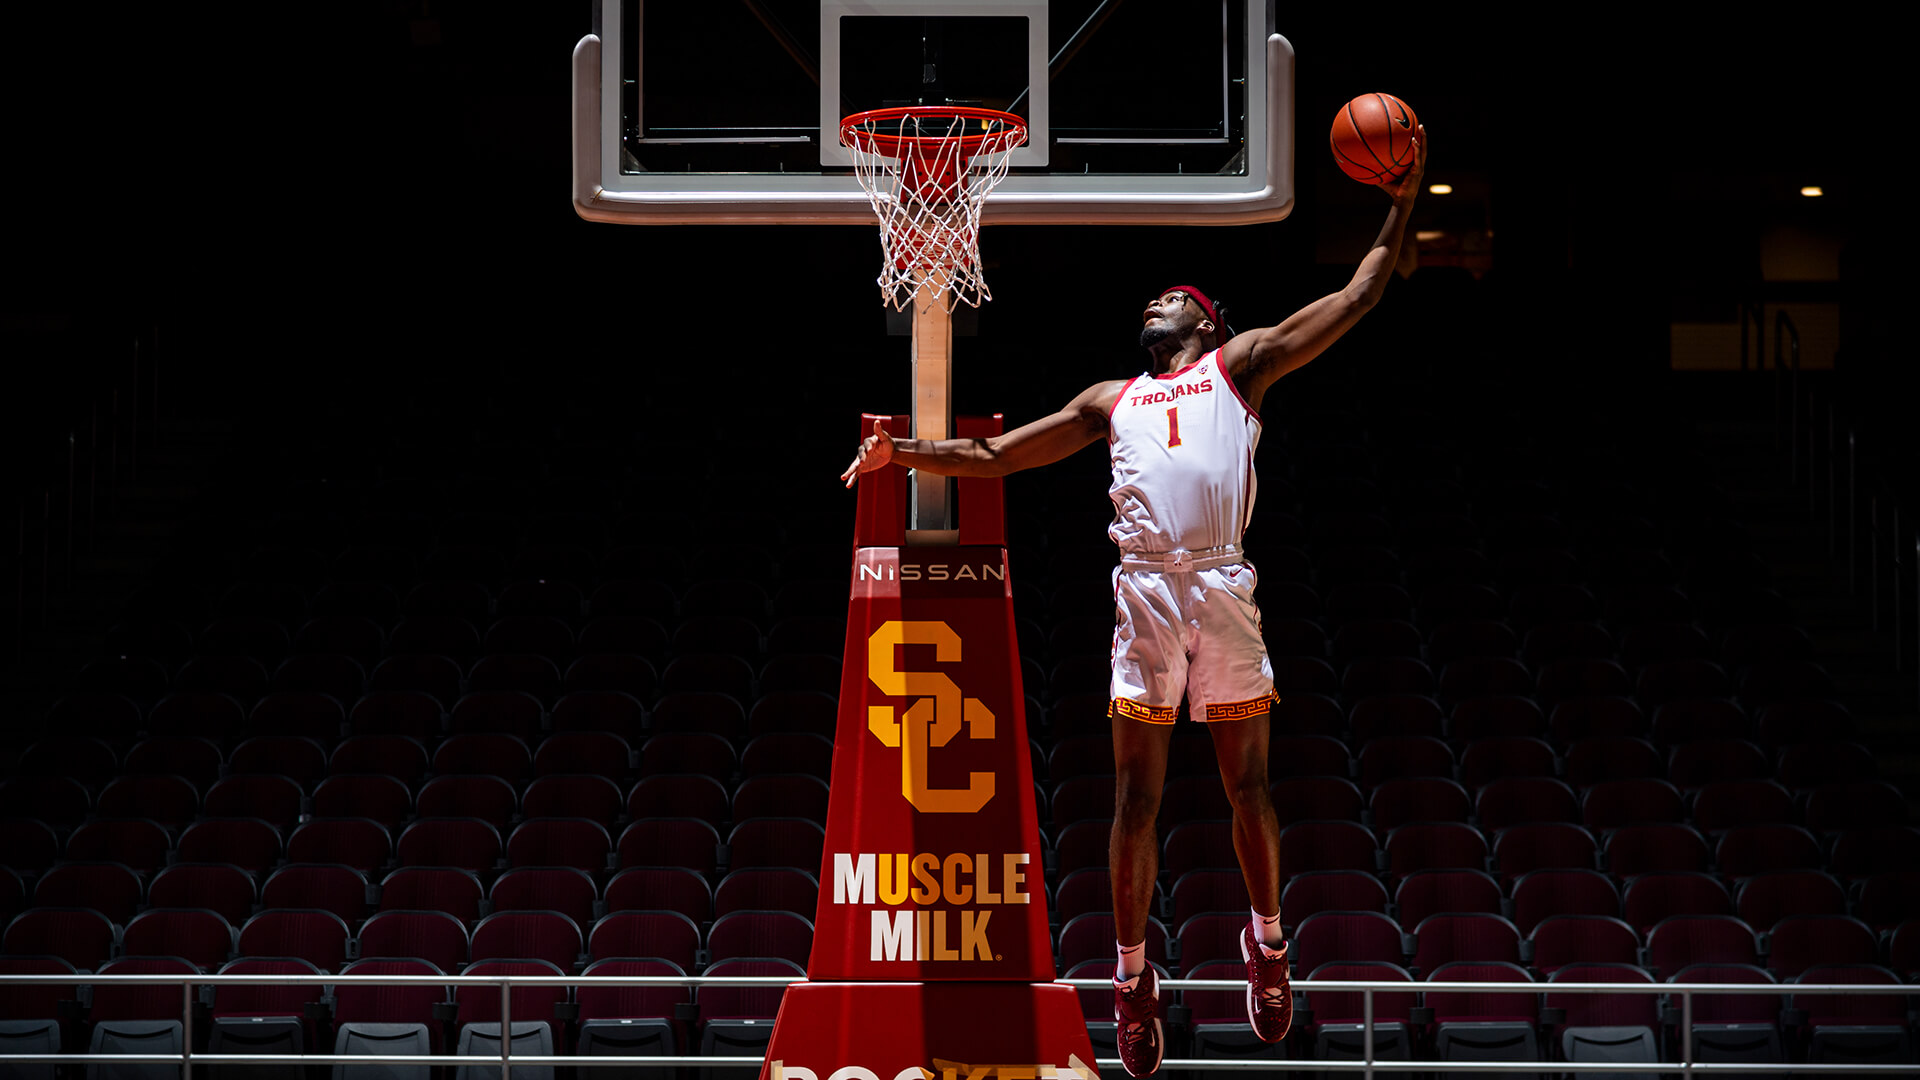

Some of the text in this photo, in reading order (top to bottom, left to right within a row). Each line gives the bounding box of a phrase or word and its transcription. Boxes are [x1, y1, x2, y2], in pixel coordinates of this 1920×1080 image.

[1130, 379, 1213, 407] TROJANS
[1166, 406, 1182, 449] 1
[859, 564, 1005, 581] NISSAN
[868, 620, 996, 813] SC
[833, 852, 1030, 905] MUSCLE
